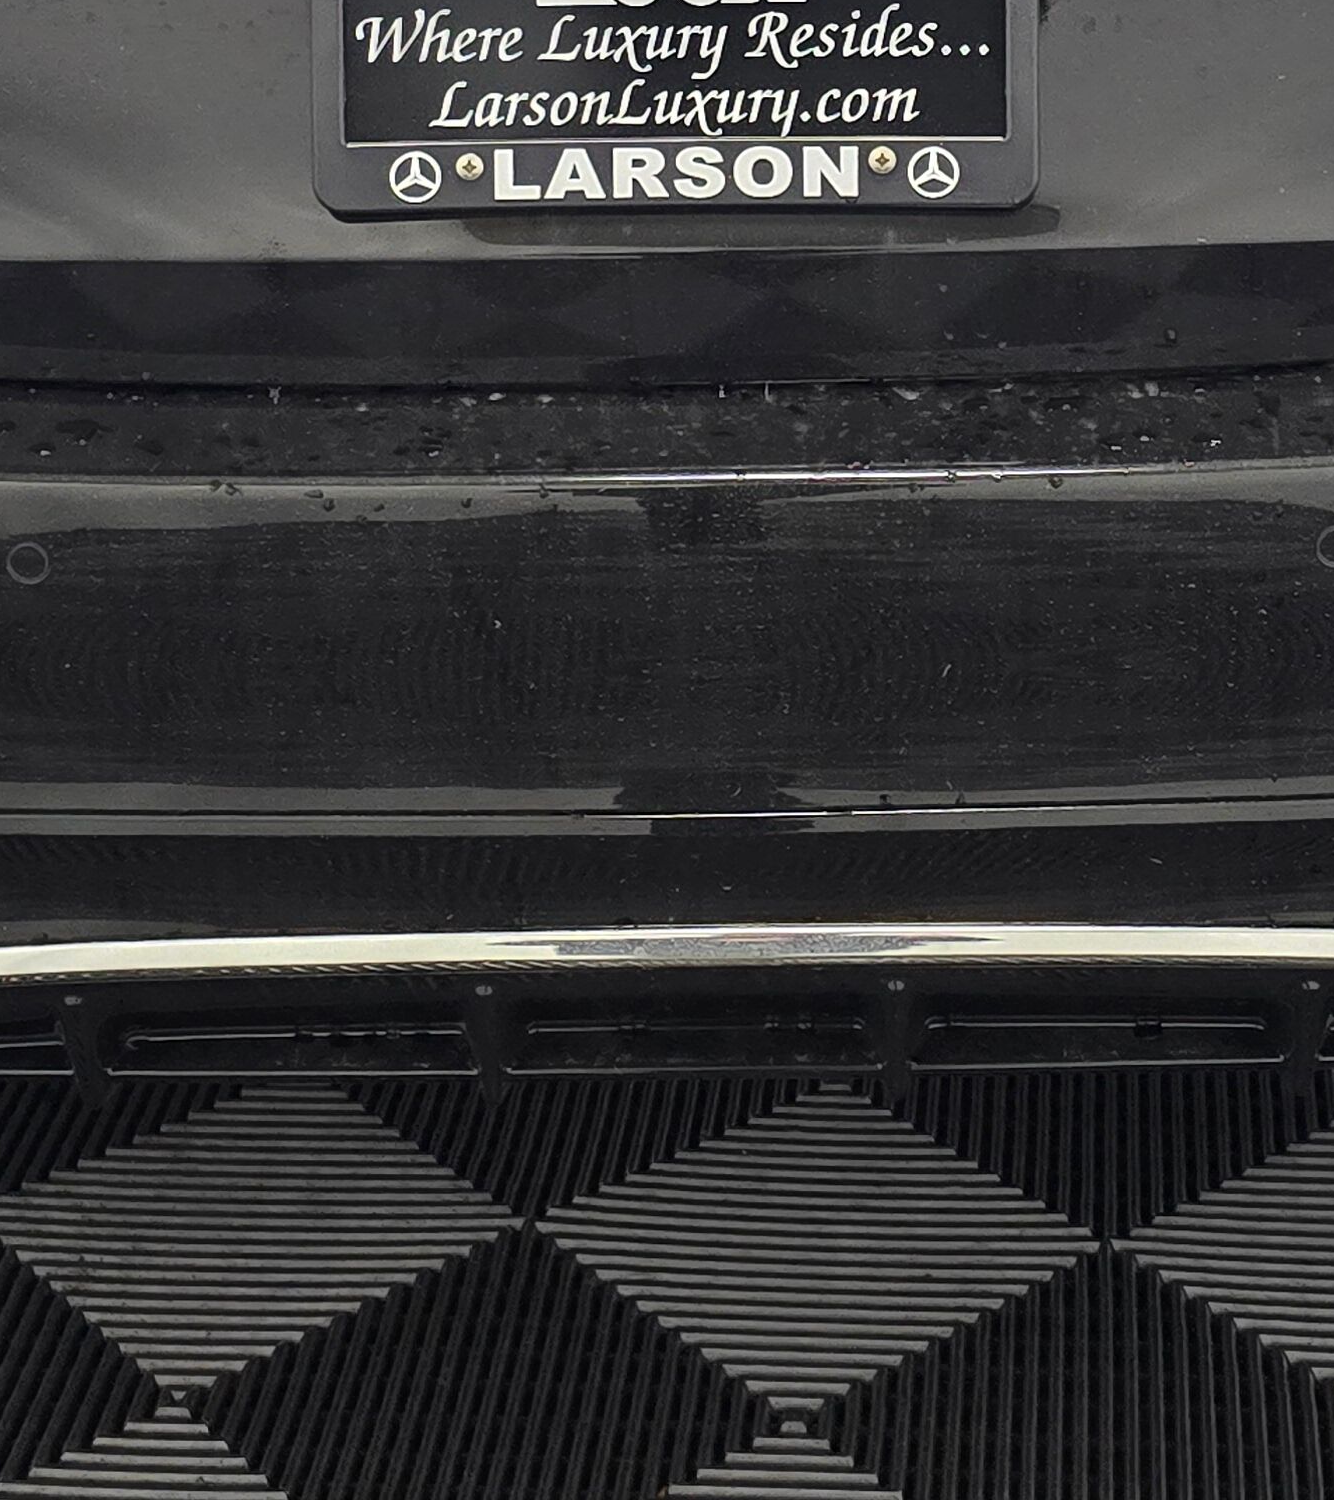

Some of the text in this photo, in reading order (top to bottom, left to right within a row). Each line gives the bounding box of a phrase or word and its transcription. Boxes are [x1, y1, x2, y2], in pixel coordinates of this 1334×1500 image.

[354, 3, 991, 78] Where Luxury Resides...
[428, 78, 920, 137] LarsonLuxury.com
[493, 145, 860, 200] LARSON
